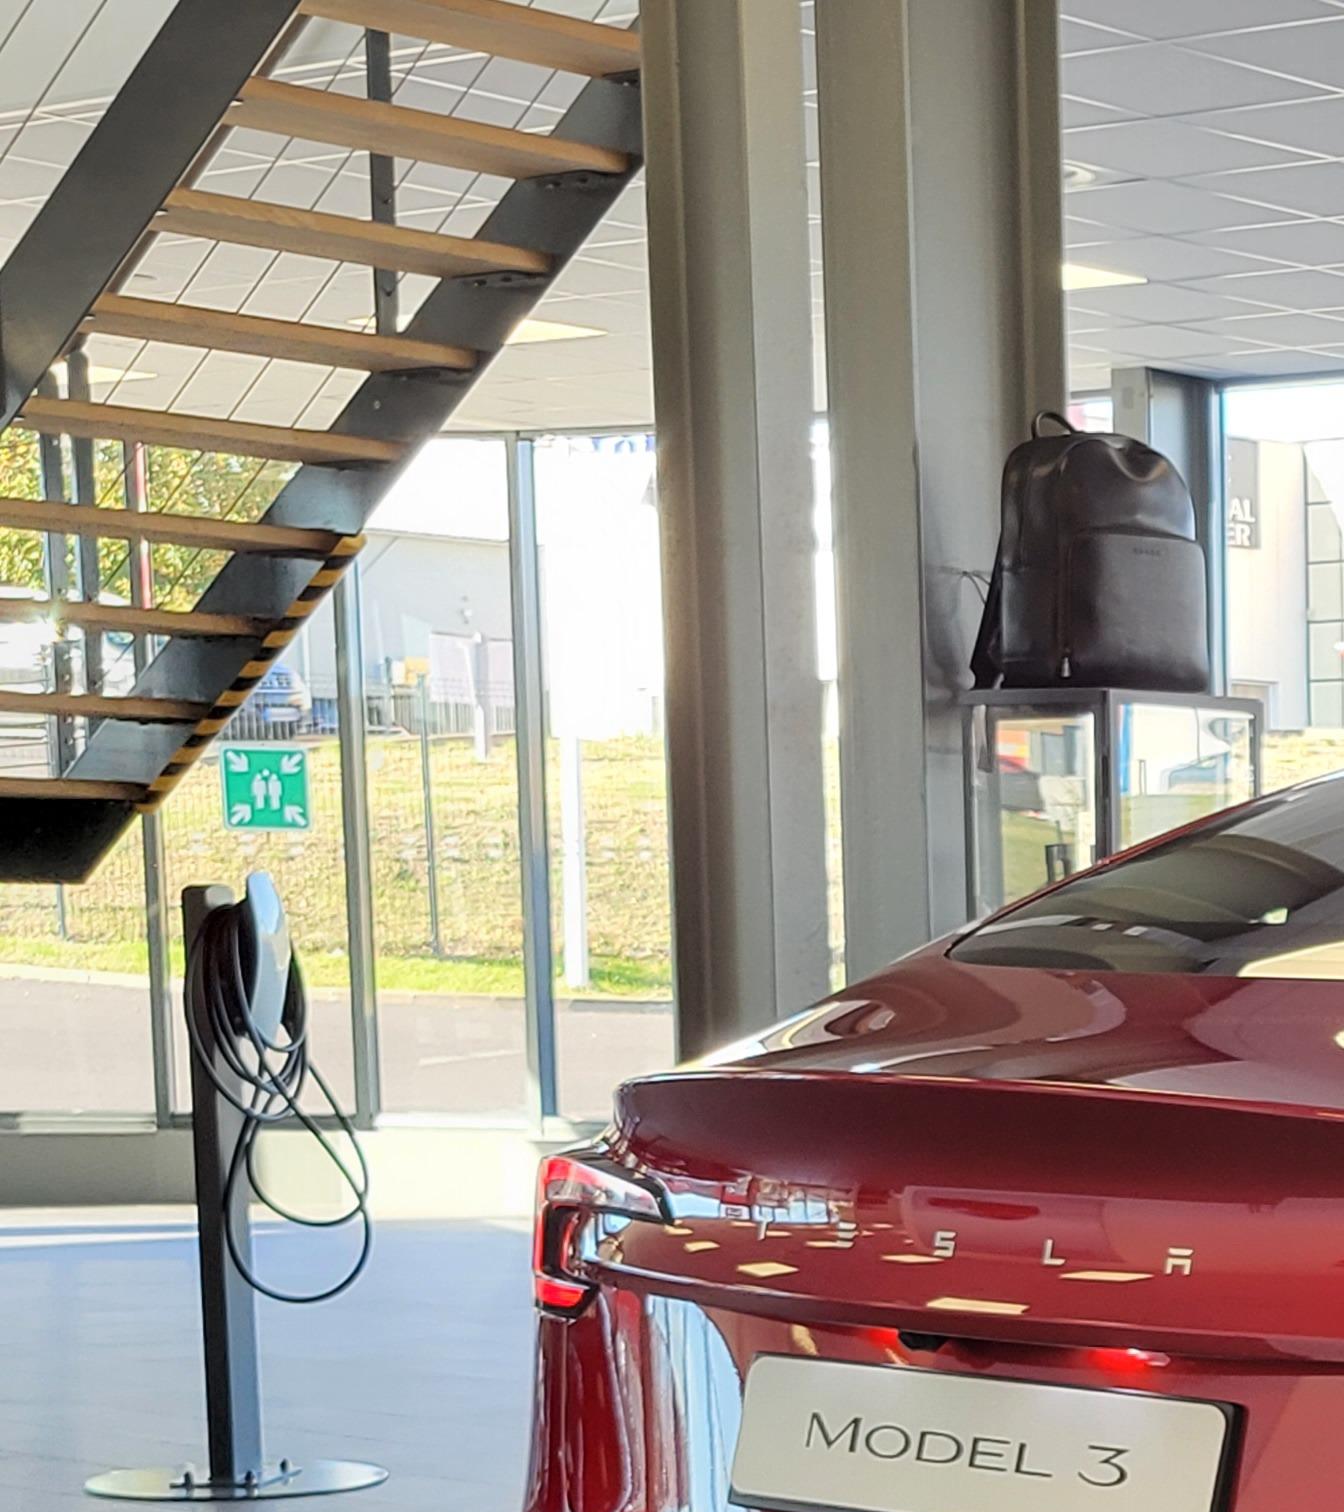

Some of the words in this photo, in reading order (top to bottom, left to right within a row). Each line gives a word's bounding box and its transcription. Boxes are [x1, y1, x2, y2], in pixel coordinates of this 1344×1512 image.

[754, 1217, 1194, 1276] TESLA
[806, 1411, 1053, 1479] MODEL
[1078, 1444, 1132, 1487] 3
